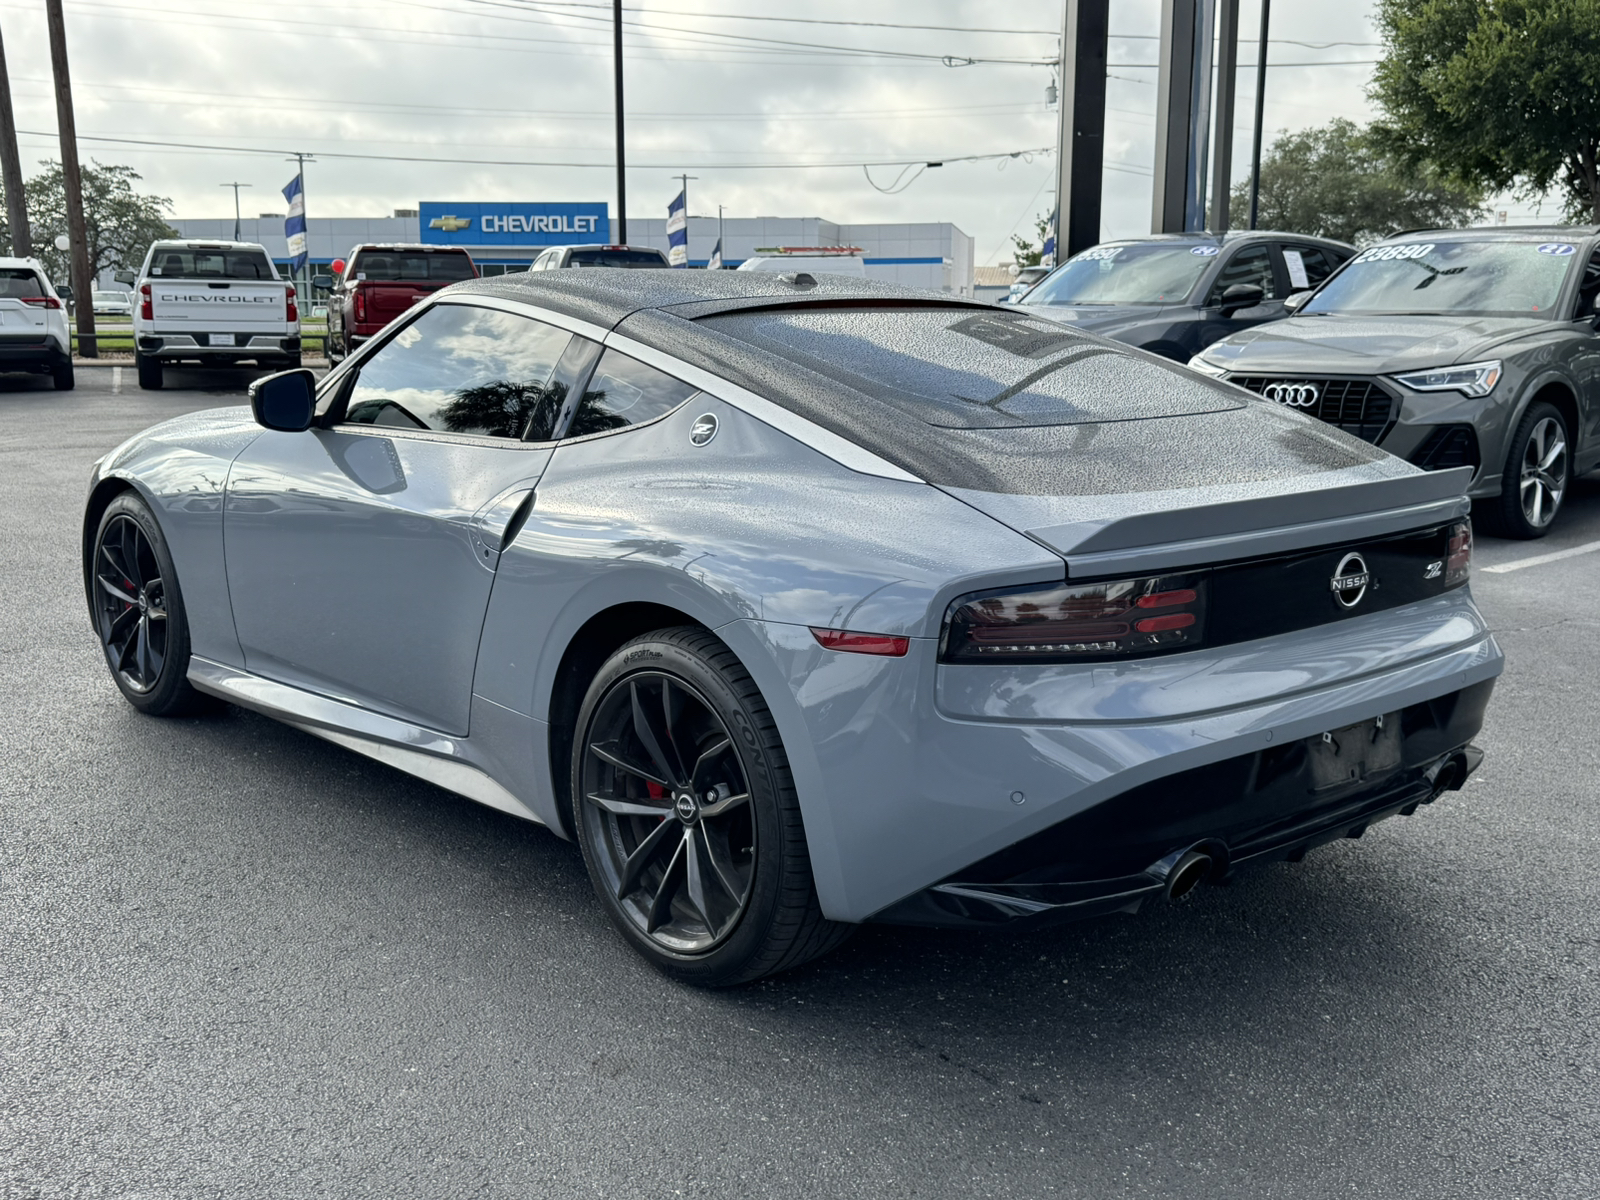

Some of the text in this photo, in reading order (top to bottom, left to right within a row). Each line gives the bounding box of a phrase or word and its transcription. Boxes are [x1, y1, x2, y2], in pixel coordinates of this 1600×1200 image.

[481, 215, 599, 232] CHEVROLET
[1352, 243, 1436, 265] 23890
[161, 294, 278, 303] CHEVROLET
